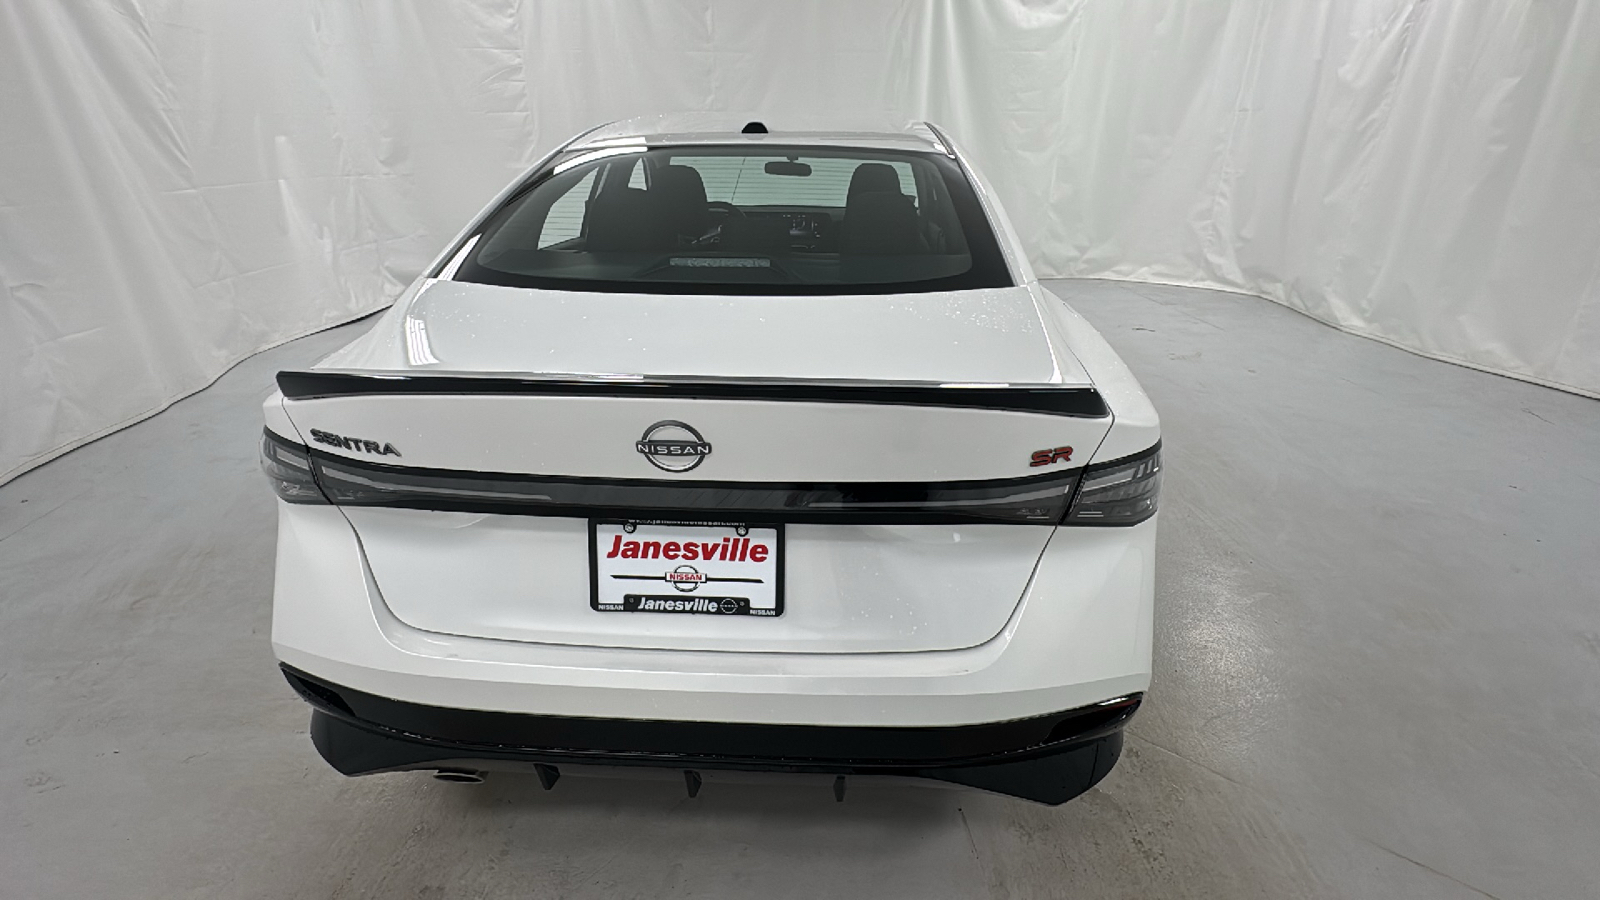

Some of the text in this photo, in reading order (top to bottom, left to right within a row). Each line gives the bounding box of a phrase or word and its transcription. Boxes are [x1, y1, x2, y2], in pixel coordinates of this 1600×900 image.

[310, 428, 402, 457] SENTRA
[638, 444, 709, 454] NISSAN
[1030, 446, 1073, 467] SR
[607, 535, 769, 562] Janesville
[669, 573, 702, 581] NISSAN
[638, 597, 718, 612] Janesville
